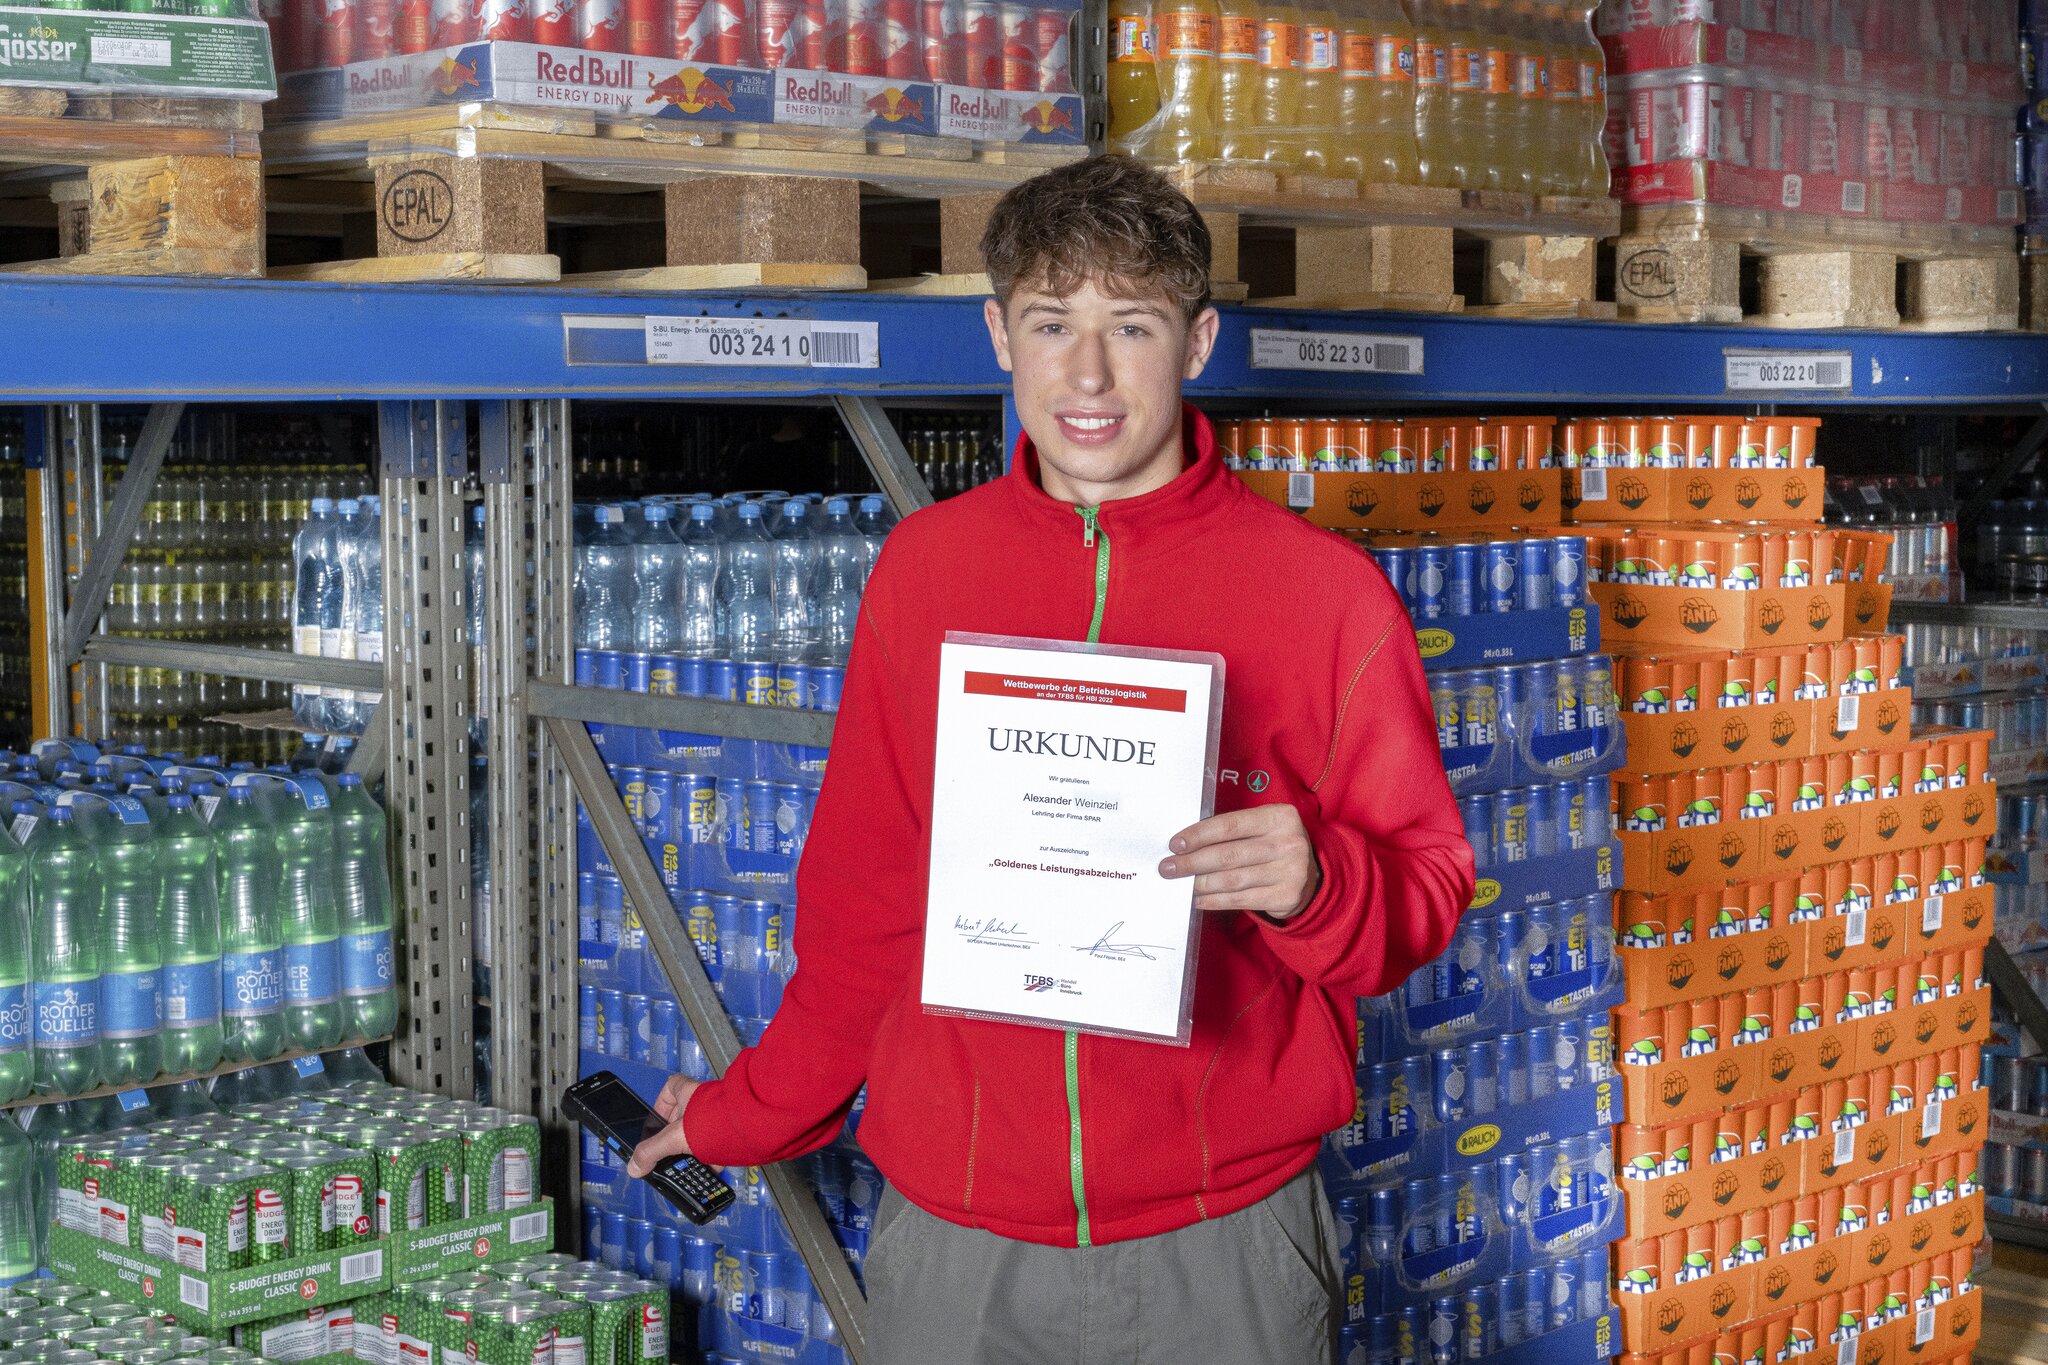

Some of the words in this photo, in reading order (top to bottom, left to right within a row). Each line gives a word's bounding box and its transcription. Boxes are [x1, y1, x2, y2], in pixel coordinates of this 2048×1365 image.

[537, 51, 587, 83] Red
[588, 58, 634, 90] Bull
[350, 67, 379, 94] Red
[537, 86, 590, 104] ENERGY
[594, 91, 634, 108] DRINK
[785, 78, 819, 103] Red
[820, 80, 852, 106] Bull
[785, 103, 821, 115] ENERGY
[950, 94, 982, 117] Red
[982, 97, 1009, 121] Bull
[950, 118, 984, 131] ENERGY
[393, 187, 443, 227] EPAL
[1629, 261, 1675, 287] EPAL
[694, 327, 710, 335] Drink
[709, 334, 745, 357] 003
[751, 335, 775, 357] 24
[782, 336, 791, 357] 1
[799, 336, 810, 358] 0
[1299, 342, 1325, 362] 003
[1330, 345, 1348, 363] 22
[1352, 346, 1360, 364] 3
[1365, 346, 1373, 364] 0
[1760, 365, 1780, 382] 003
[1783, 365, 1796, 381] 22
[1799, 365, 1805, 381] 2
[1808, 365, 1814, 381] 0
[1003, 679, 1060, 692] Wettbewerbe
[1062, 684, 1077, 693] der
[1079, 686, 1147, 699] Betriebslogistik
[1098, 696, 1114, 704] 2022
[988, 727, 1156, 766] URKUNDE
[1059, 777, 1090, 785] gratulieren
[1023, 792, 1072, 806] Alexander
[1074, 797, 1119, 811] Weinzierl
[1031, 810, 1055, 818] Lehrling
[1049, 846, 1090, 857] Auszeichnung
[1474, 884, 1497, 899] AUCH
[1024, 974, 1054, 987] TFBS
[1059, 988, 1083, 996] Innsbruck
[40, 1017, 95, 1036] QUELLE
[1468, 1130, 1496, 1149] RAUCH
[261, 1220, 286, 1229] ENERGY
[263, 1227, 284, 1237] DRINK
[357, 1219, 369, 1231] XL
[410, 1233, 449, 1251] S-BUDGET
[449, 1227, 478, 1245] ENERGY
[478, 1222, 503, 1240] DRINK
[441, 1240, 472, 1257] CLASSIC
[476, 1241, 488, 1254] XL
[122, 1255, 142, 1272] ENERGY
[142, 1263, 162, 1279] DRINK
[409, 1267, 419, 1276] 24
[423, 1264, 433, 1273] 355
[433, 1262, 440, 1270] ml
[118, 1269, 140, 1285] CLASSIC
[143, 1281, 154, 1294] XL
[229, 1276, 270, 1294] S-BUDGET
[270, 1268, 306, 1286] ENERGY
[304, 1262, 332, 1281] DRINK
[263, 1283, 298, 1300] CLASSIC
[303, 1283, 316, 1296] XL
[228, 1307, 238, 1318] 24
[242, 1305, 254, 1315] 355
[254, 1303, 261, 1313] ml
